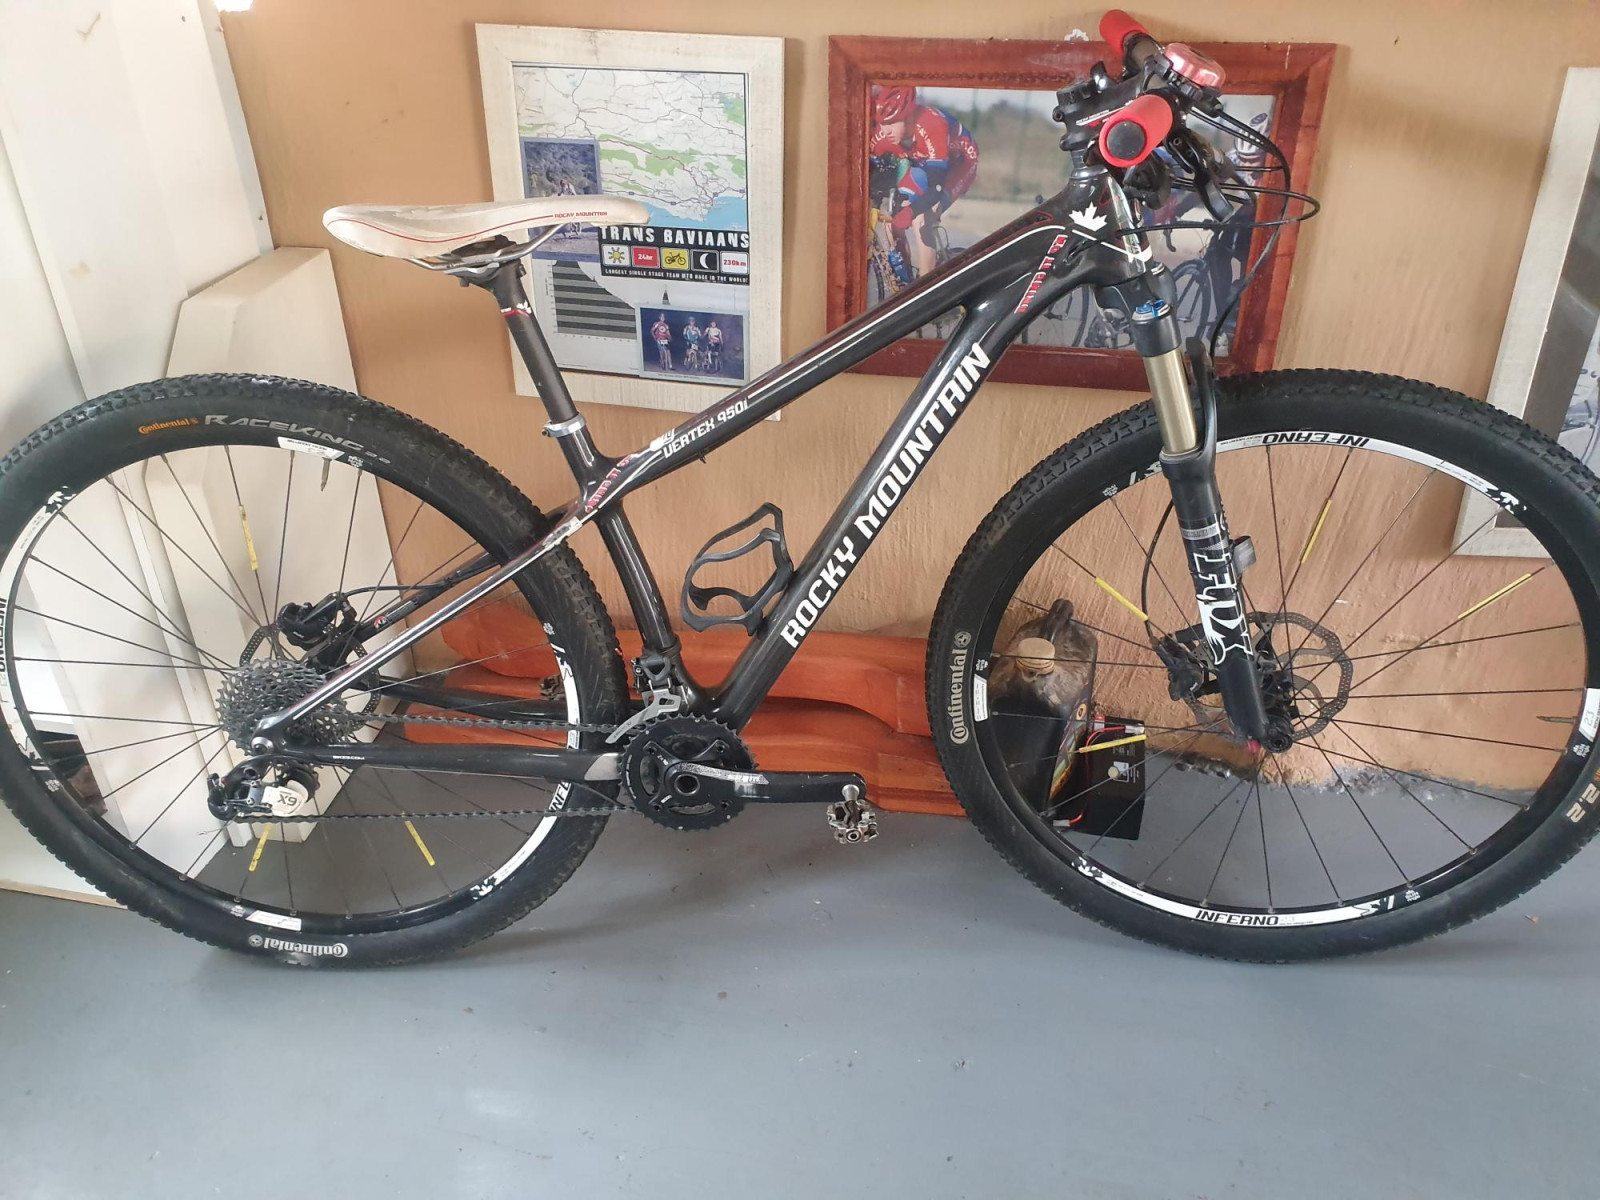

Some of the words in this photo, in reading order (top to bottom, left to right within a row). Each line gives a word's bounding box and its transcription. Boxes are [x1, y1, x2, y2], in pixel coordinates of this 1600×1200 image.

[601, 226, 655, 243] TRANS
[663, 229, 750, 249] BAVIAANS
[637, 253, 653, 261] 24hr
[723, 259, 747, 267] 230km
[663, 418, 715, 458] VERTEX
[1262, 432, 1370, 448] INFERNO
[780, 535, 857, 648] ROCKY
[854, 342, 992, 539] MOUNTAIN
[948, 648, 970, 744] Continental
[277, 794, 298, 807] X9
[1195, 910, 1279, 926] INFERNO
[263, 937, 348, 958] Continental
